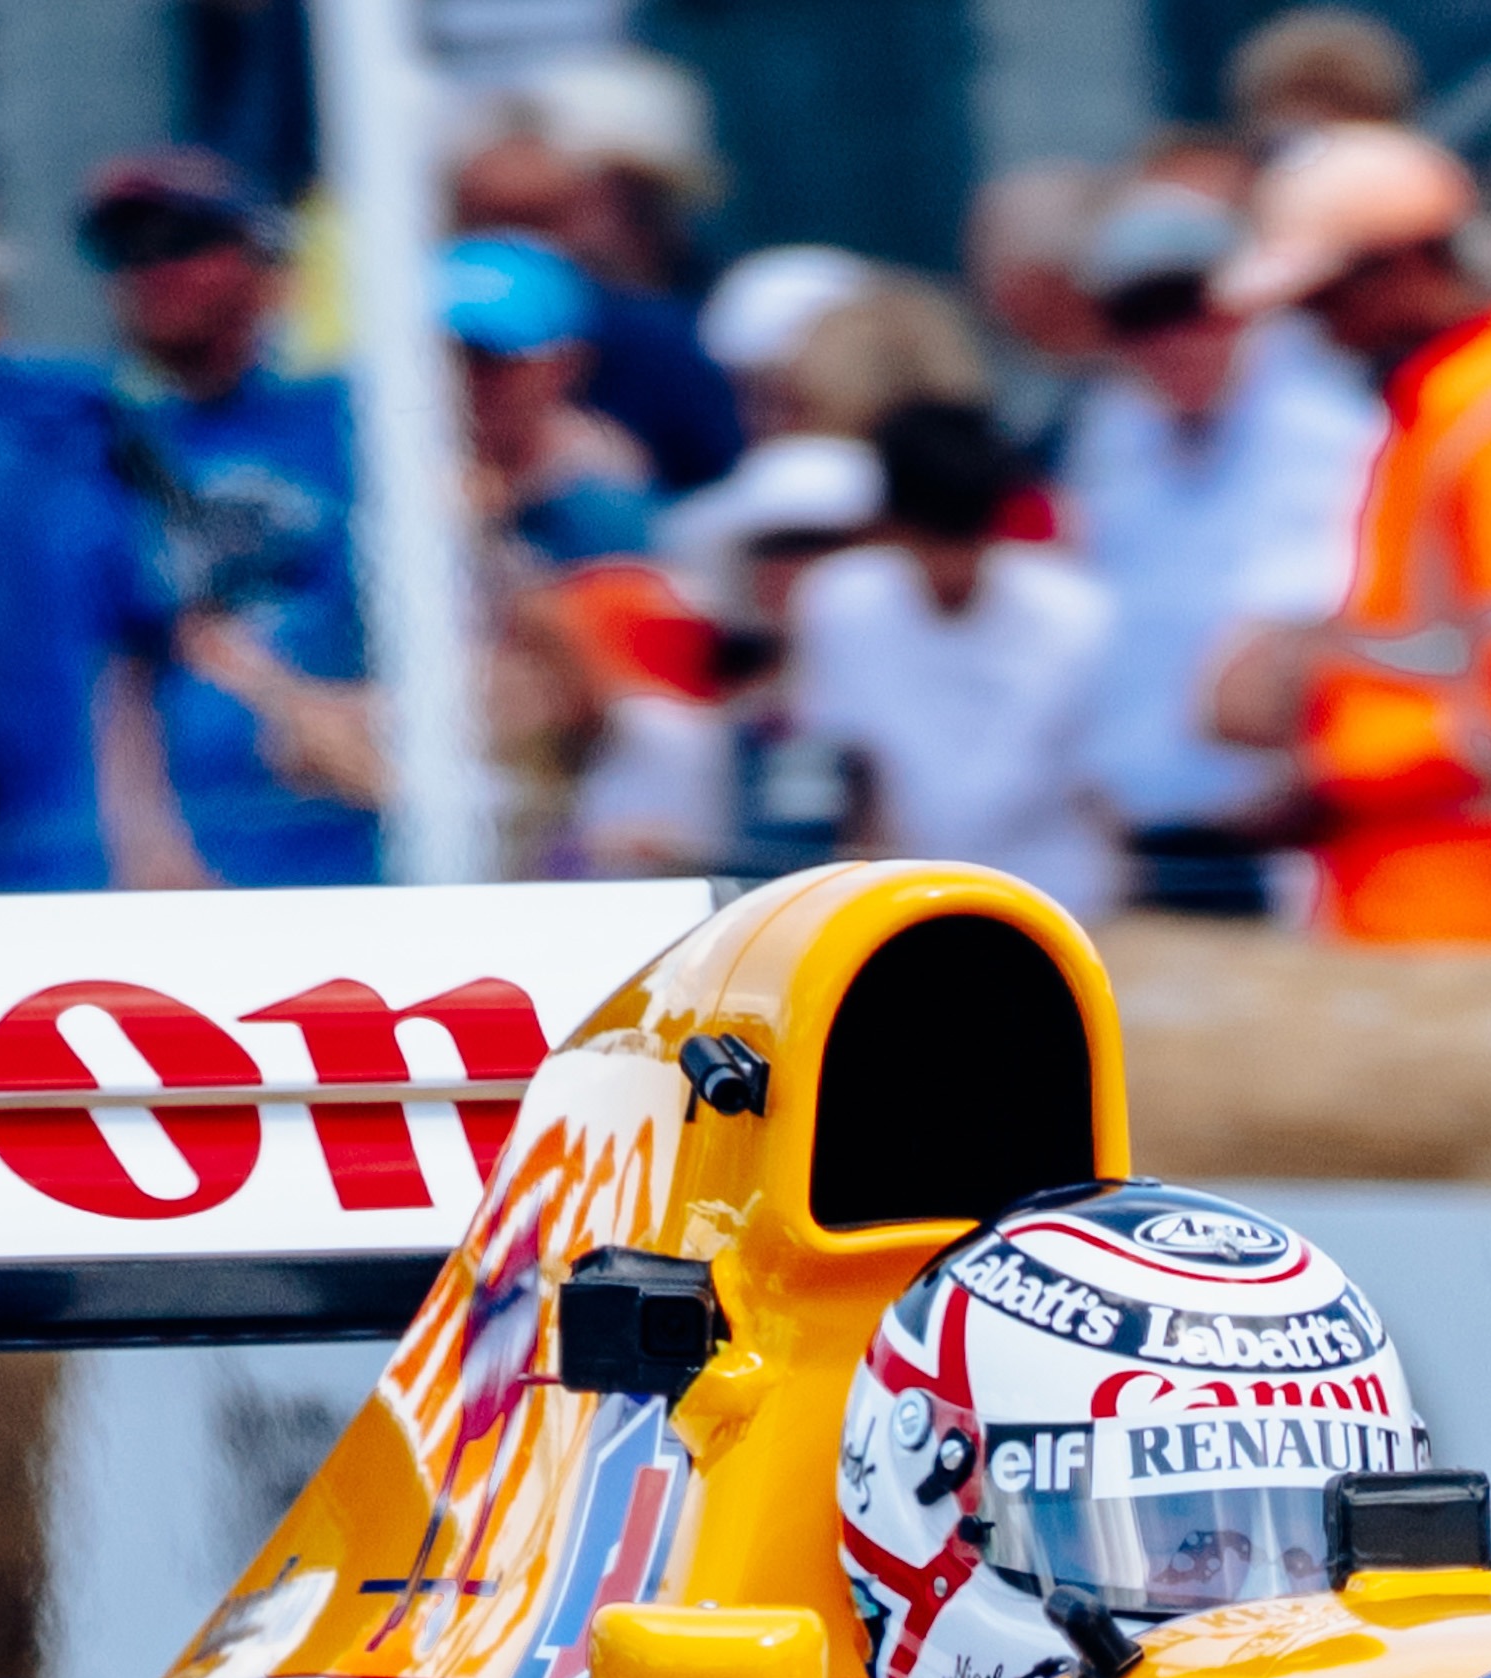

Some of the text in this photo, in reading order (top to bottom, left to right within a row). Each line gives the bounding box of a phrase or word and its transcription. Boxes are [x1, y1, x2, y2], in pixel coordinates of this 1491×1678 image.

[950, 1236, 1121, 1346] Labatt's
[1137, 1304, 1363, 1370] Labatt's
[990, 1431, 1088, 1493] elf
[1125, 1416, 1400, 1480] RENAULT
